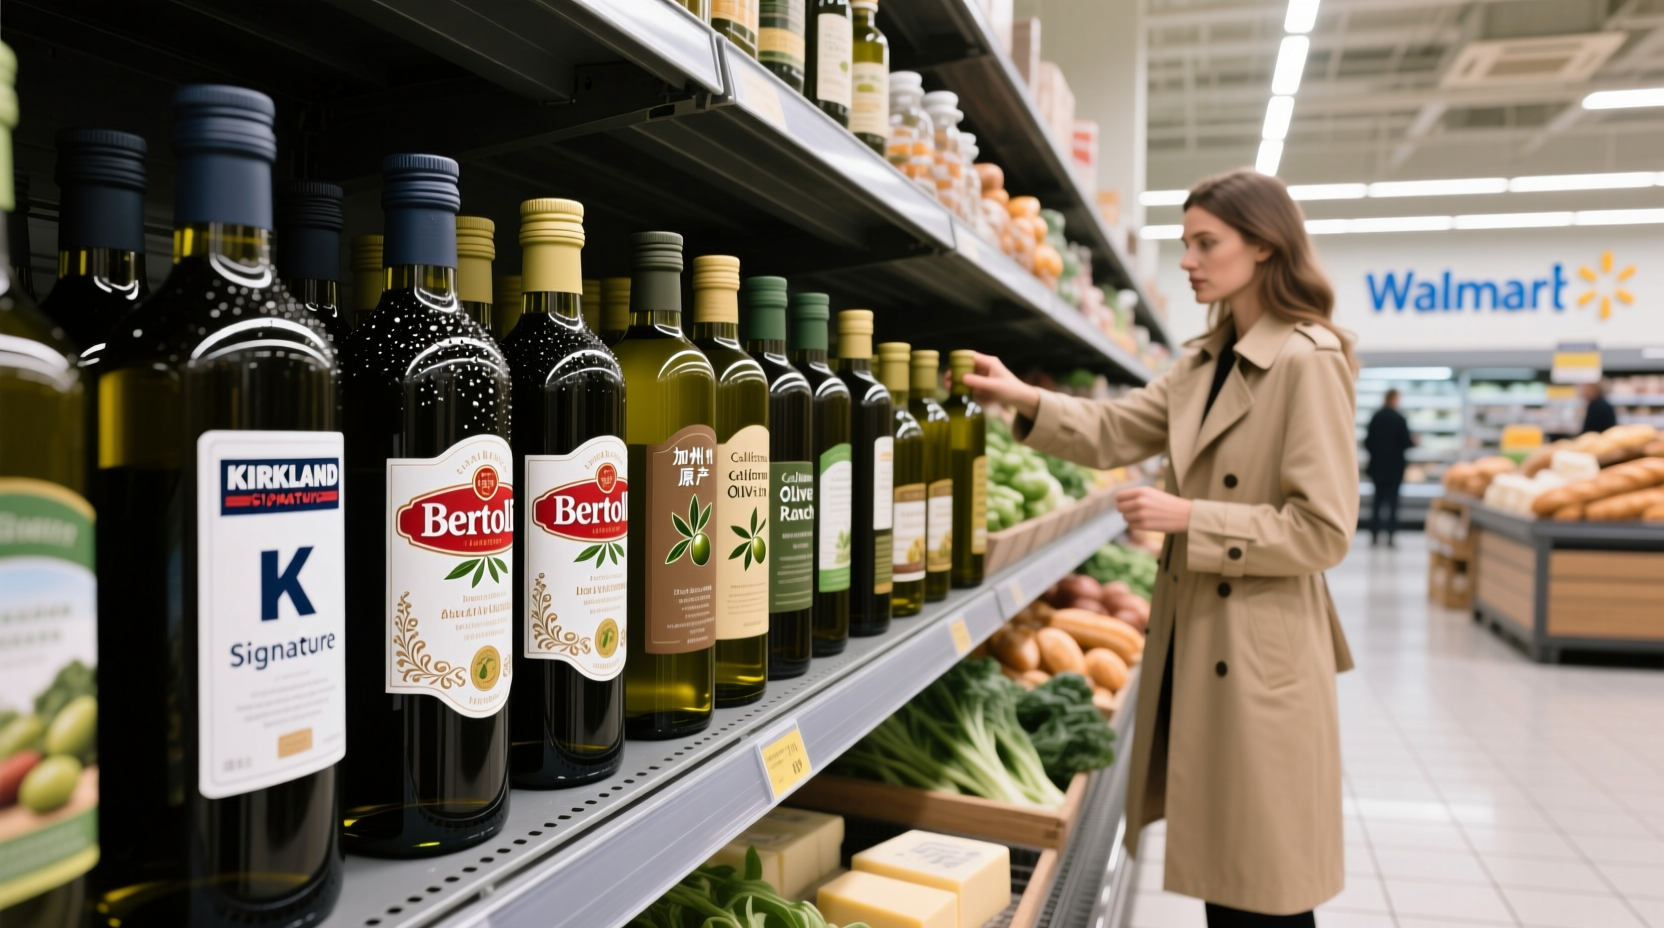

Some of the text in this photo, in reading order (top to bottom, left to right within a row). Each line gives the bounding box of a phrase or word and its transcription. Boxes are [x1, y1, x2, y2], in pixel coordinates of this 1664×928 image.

[1367, 264, 1568, 311] Walmart
[227, 464, 338, 490] KIRKLAND
[261, 546, 316, 622] K
[230, 633, 335, 670] Signature
